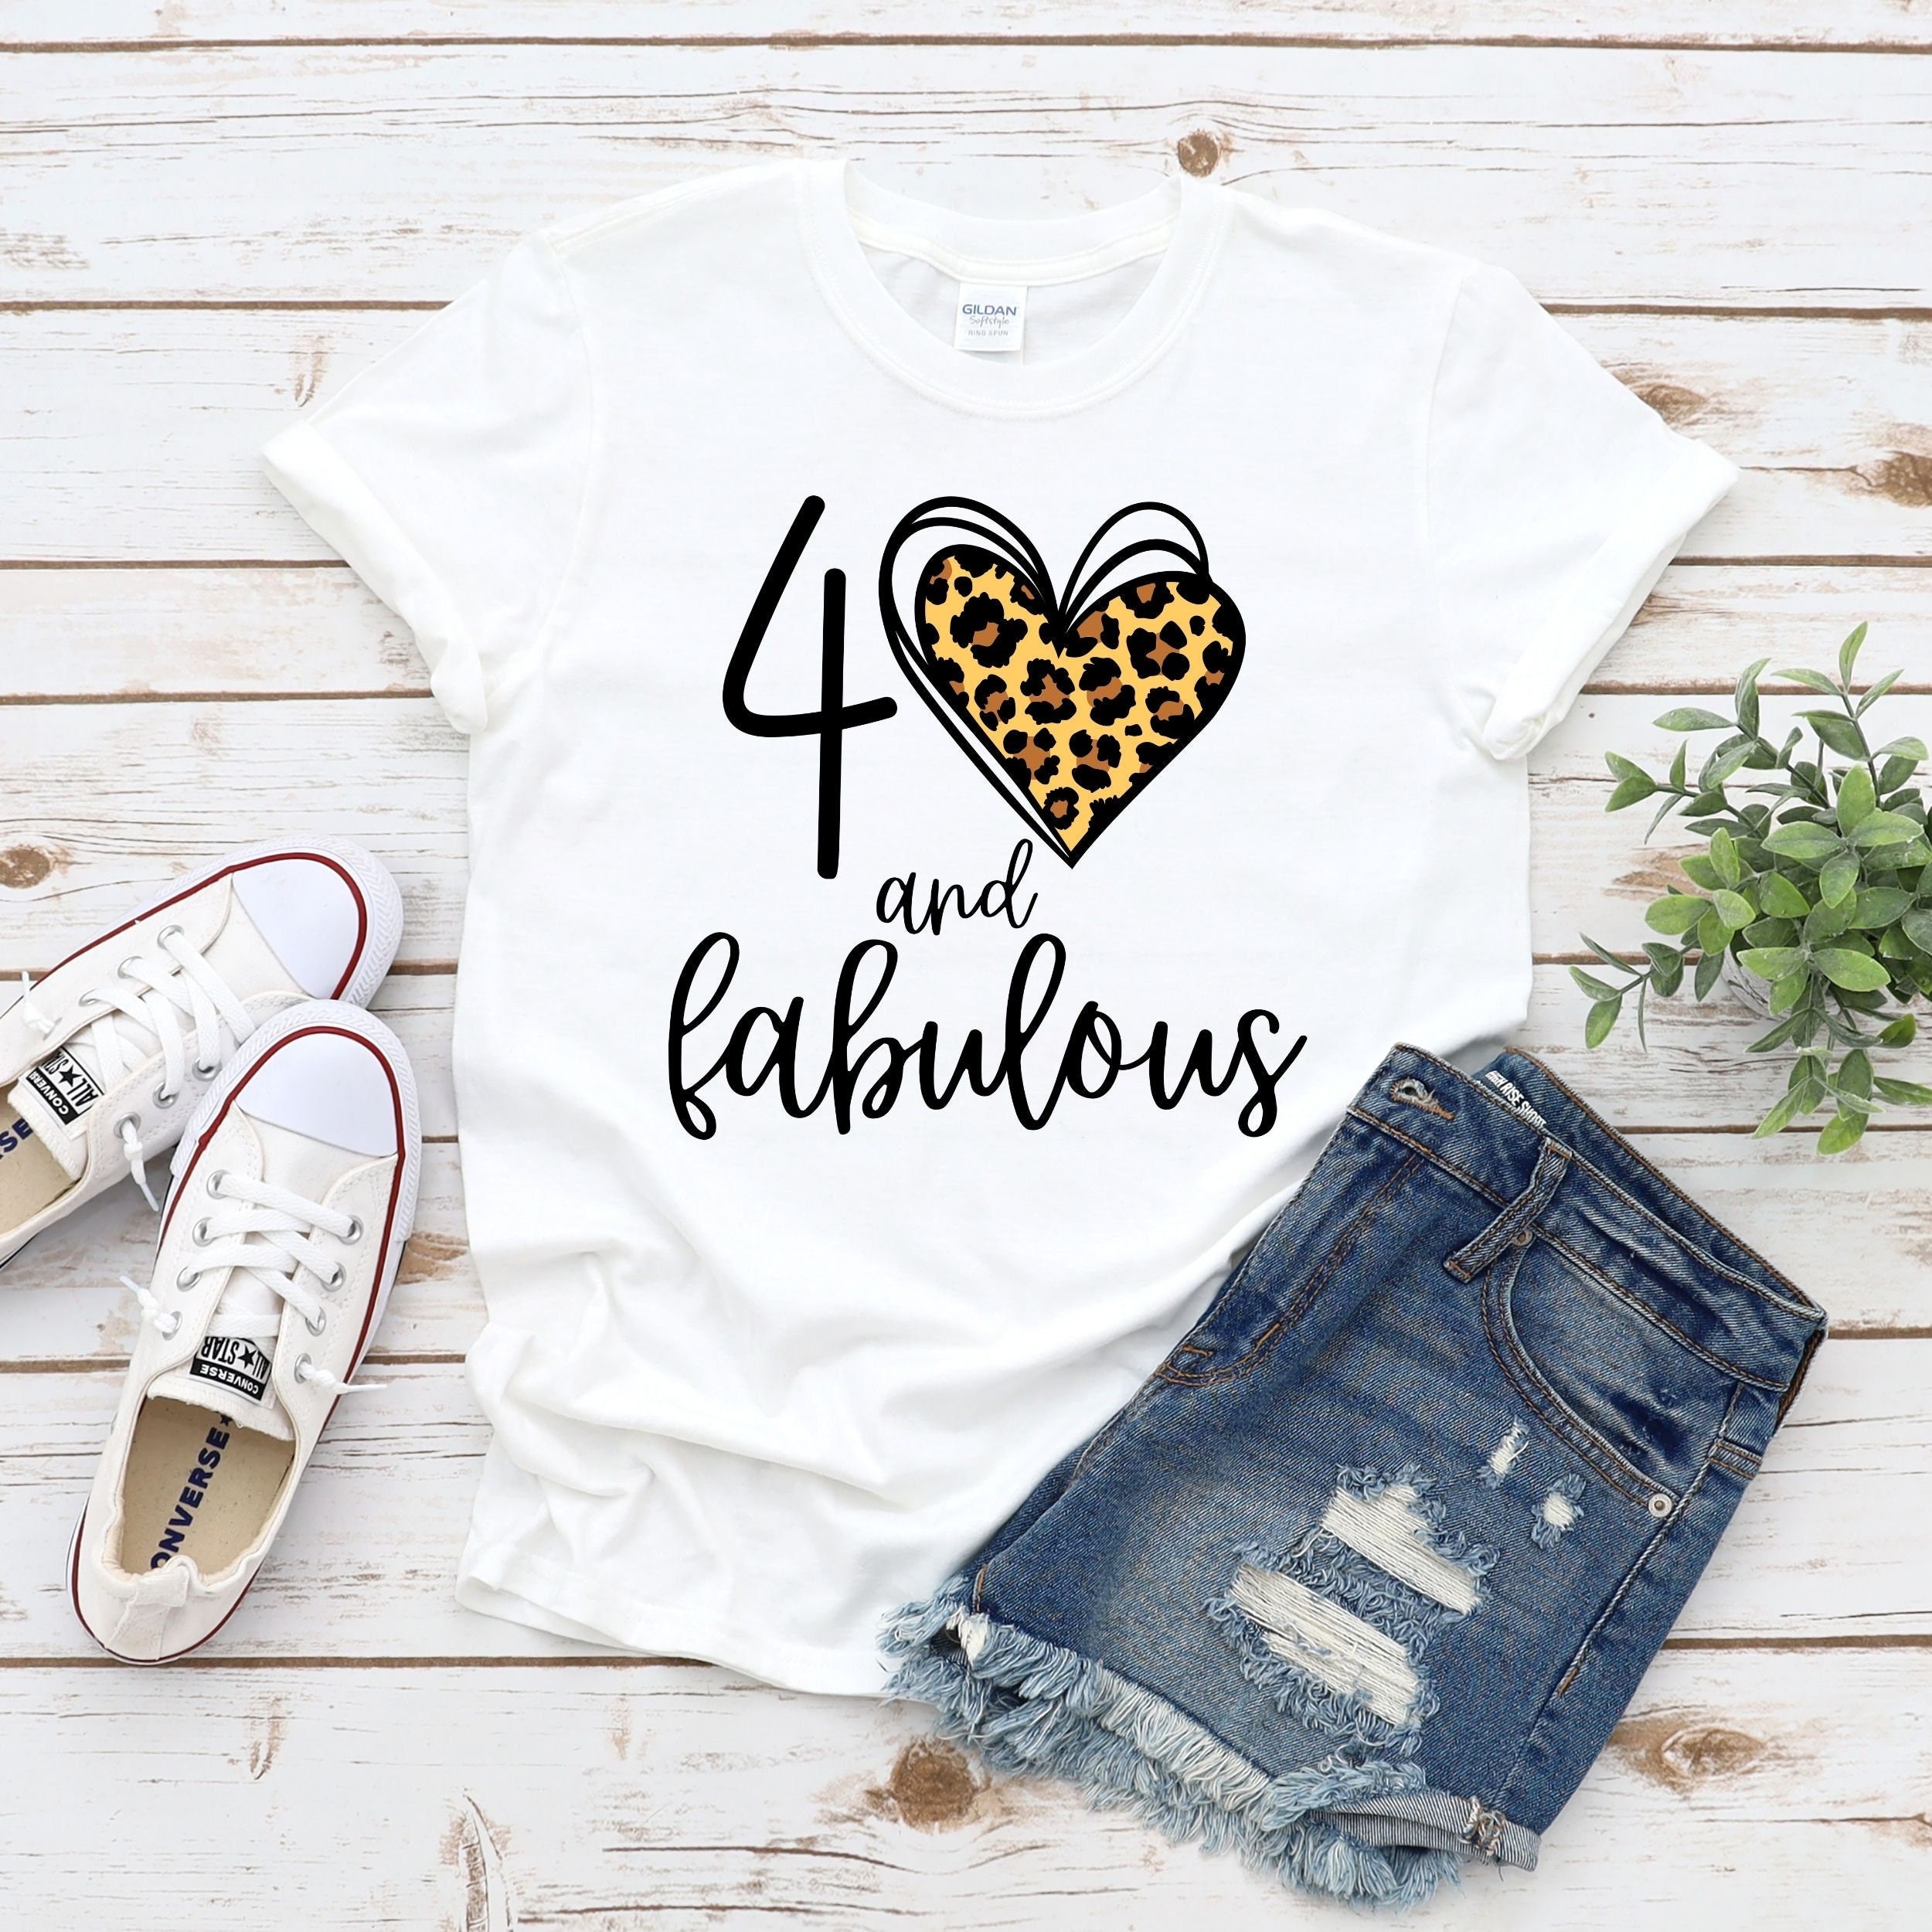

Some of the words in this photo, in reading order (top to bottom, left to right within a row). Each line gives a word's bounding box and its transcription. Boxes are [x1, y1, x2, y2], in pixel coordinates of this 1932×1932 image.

[962, 304, 1017, 315] GILDAN
[969, 315, 1010, 328] Softstyle
[876, 838, 1038, 935] and
[668, 932, 1307, 1140] fabulous
[41, 1052, 70, 1075] STA
[66, 1077, 99, 1107] ALL
[1499, 1082, 1525, 1106] RISE
[201, 1336, 240, 1365] STAR
[199, 1363, 259, 1395] CONVERSE
[150, 1427, 230, 1570] ONVERSE
